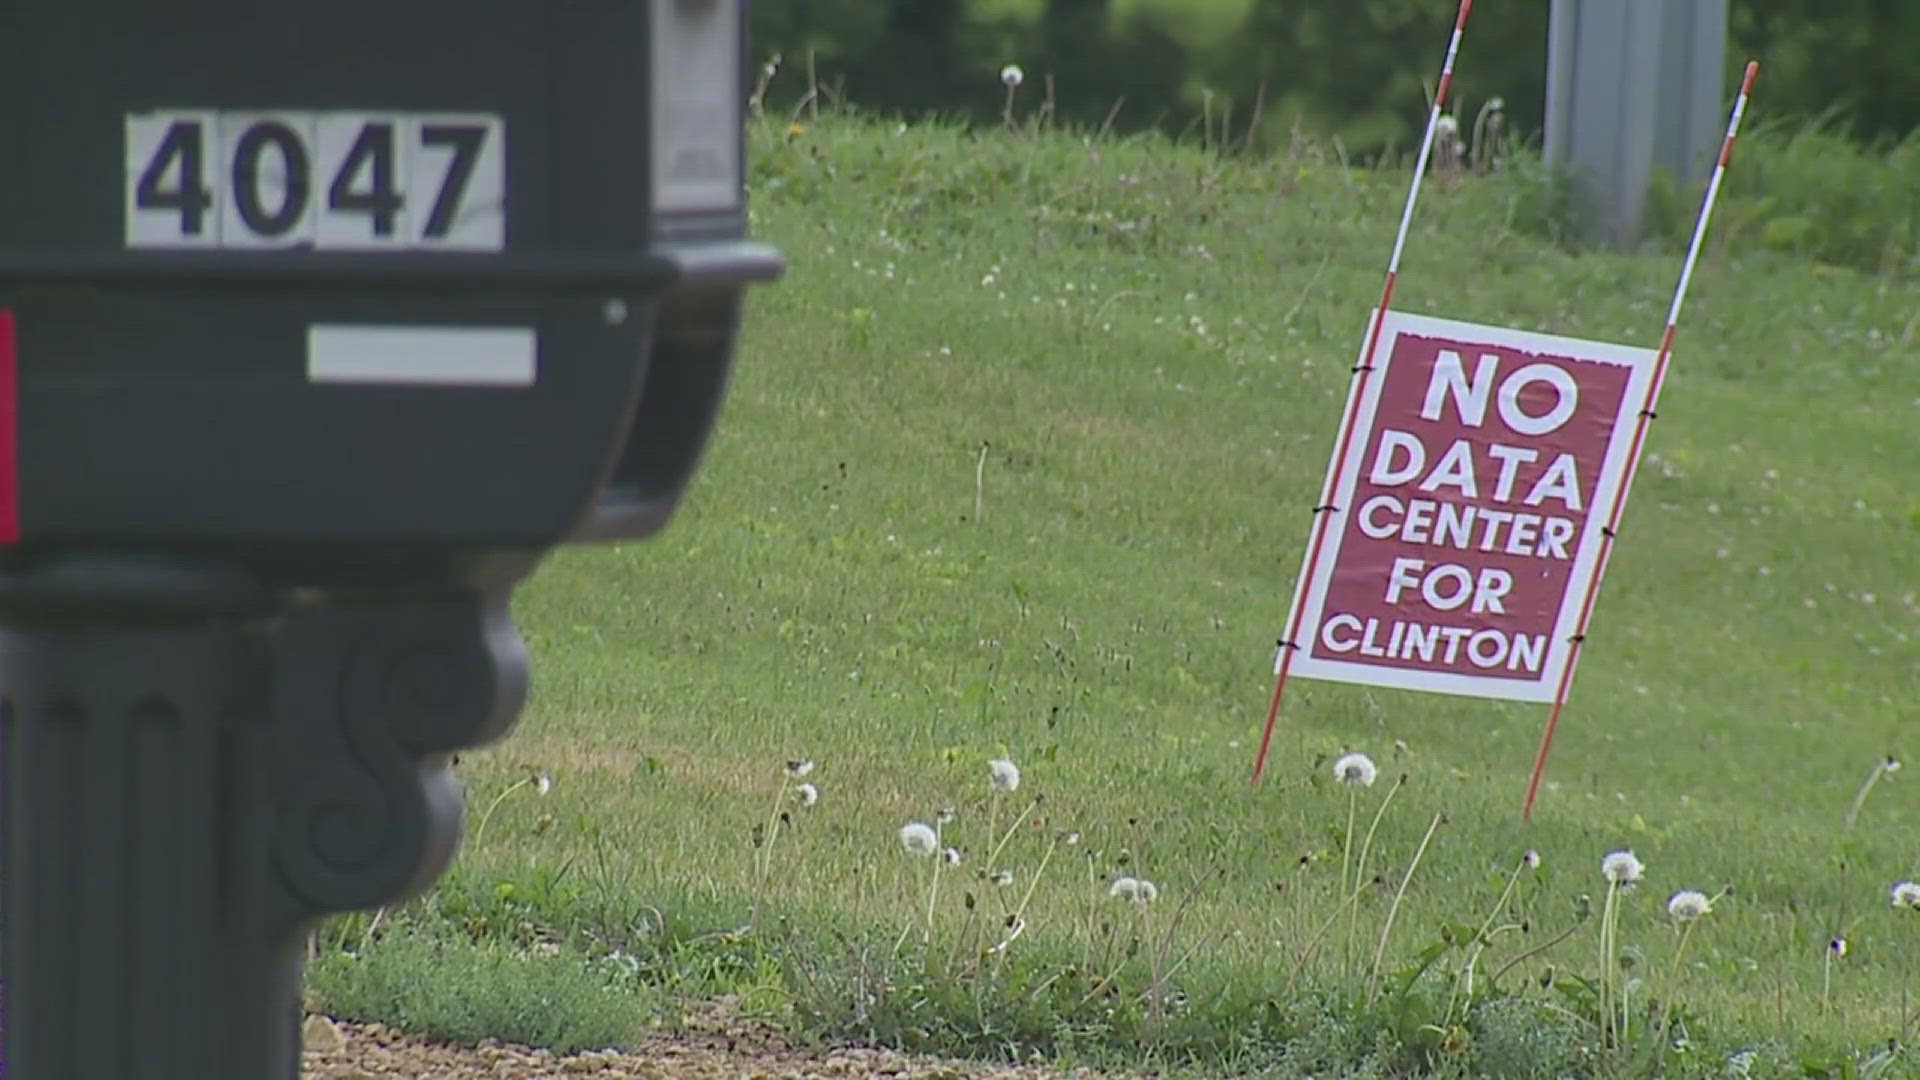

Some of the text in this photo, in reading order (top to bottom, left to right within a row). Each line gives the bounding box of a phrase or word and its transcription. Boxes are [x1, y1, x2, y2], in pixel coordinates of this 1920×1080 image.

[135, 120, 490, 240] 4047
[1420, 349, 1578, 436] NO
[1369, 429, 1582, 512] DATA
[1357, 495, 1575, 559] CENTER
[1384, 557, 1512, 615] FOR
[1321, 613, 1547, 672] CLINTON
